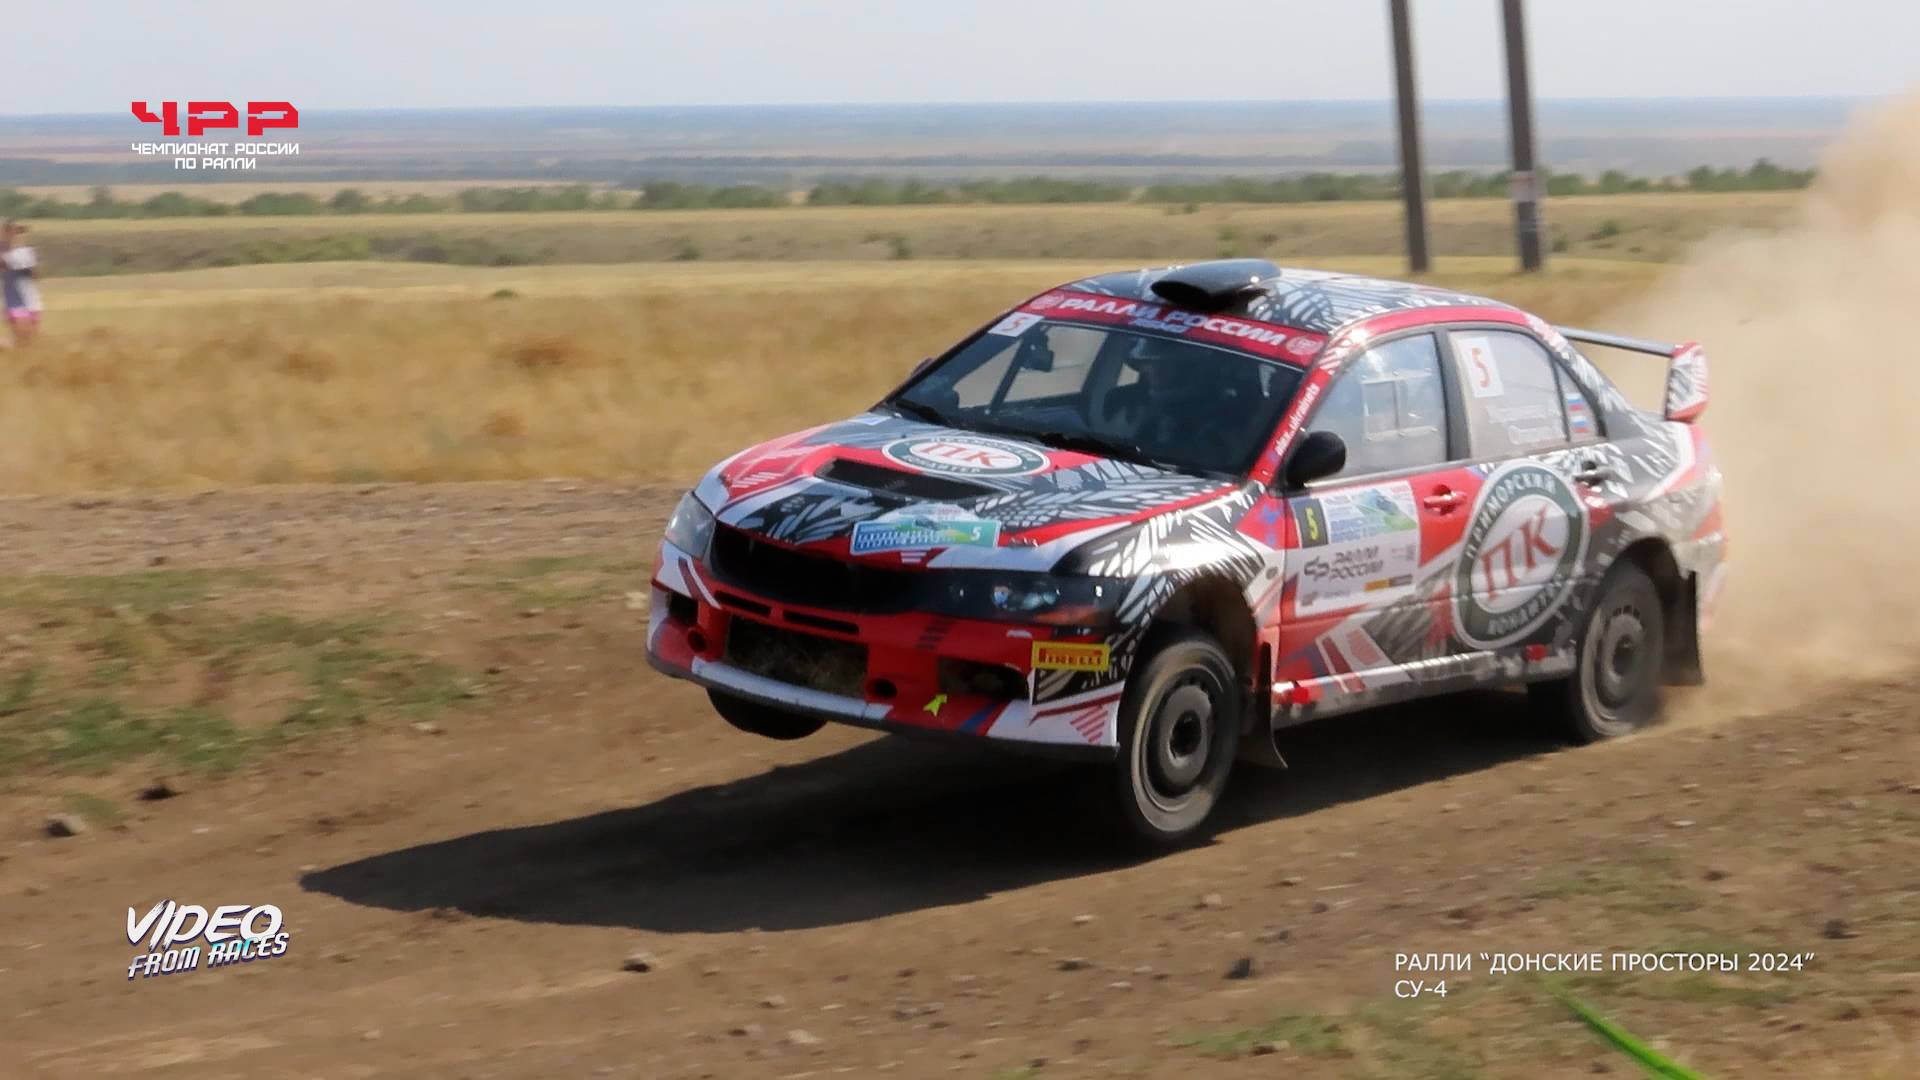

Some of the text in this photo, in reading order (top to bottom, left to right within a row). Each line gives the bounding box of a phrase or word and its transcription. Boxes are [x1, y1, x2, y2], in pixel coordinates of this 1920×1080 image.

[1058, 297, 1159, 322] РАЛЛИ
[1164, 310, 1287, 346] РОССИИ
[1471, 347, 1490, 388] 5
[970, 526, 983, 542] 5
[1305, 506, 1319, 540] 5
[1480, 503, 1562, 602] ПК
